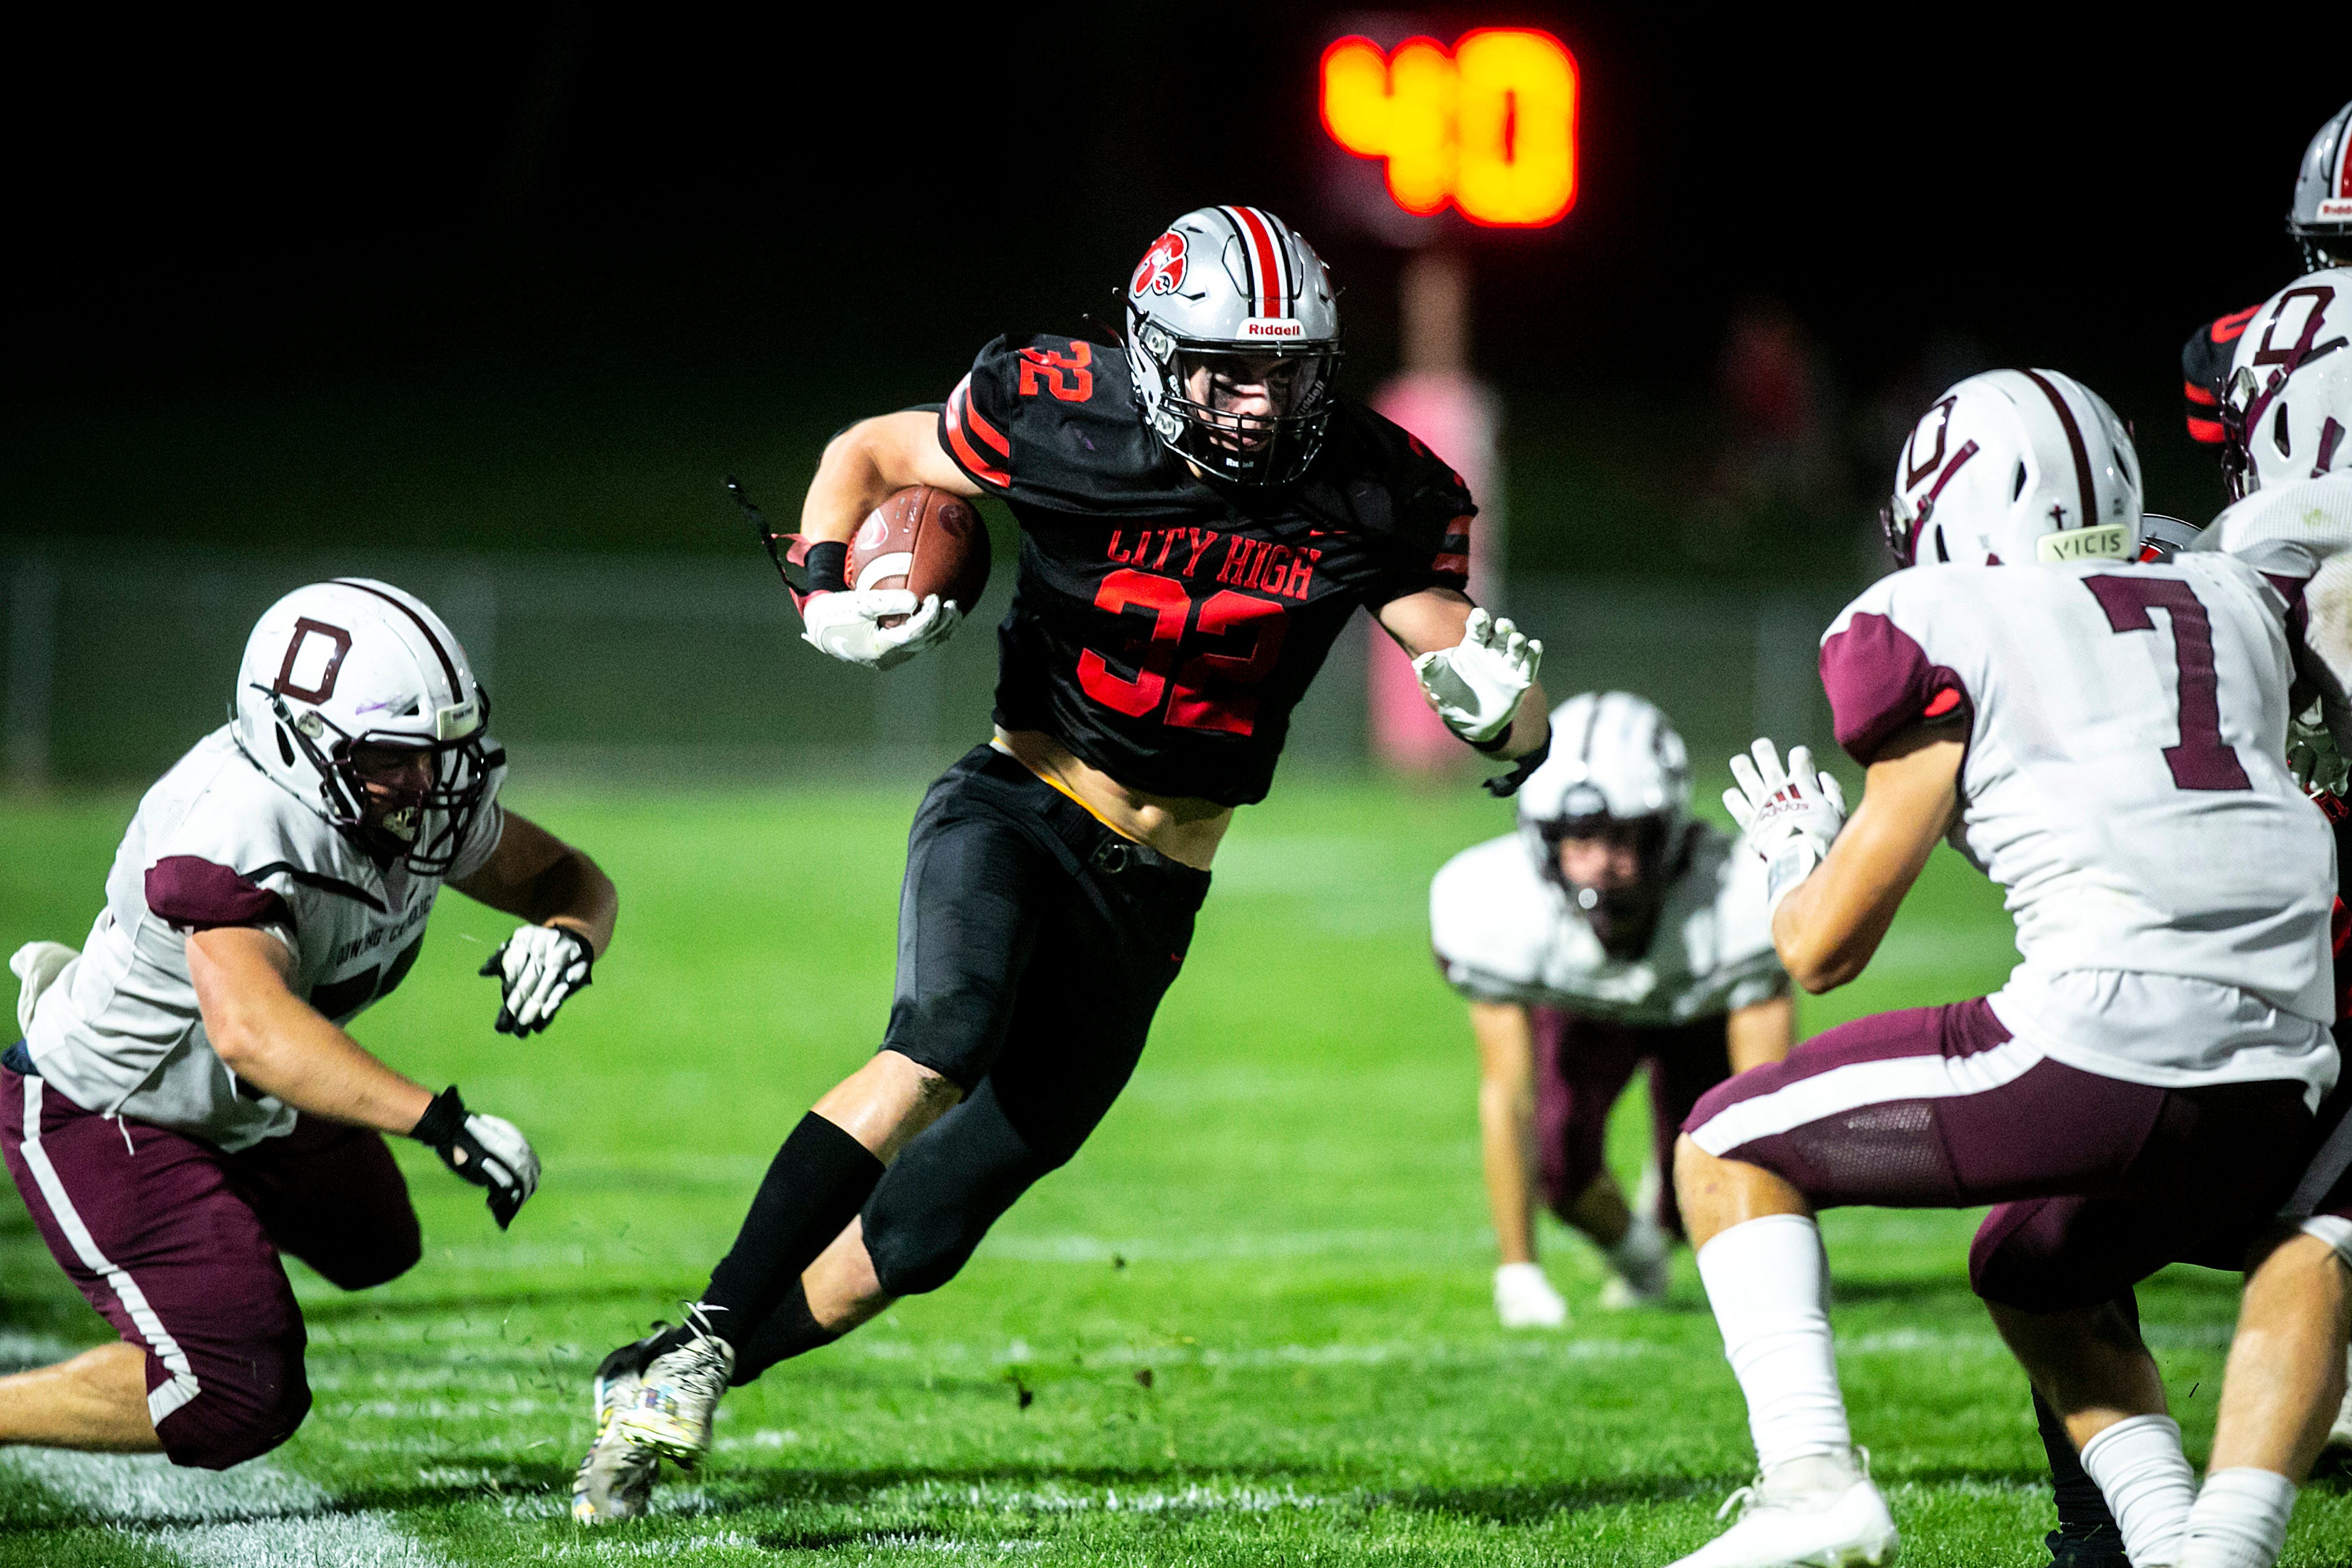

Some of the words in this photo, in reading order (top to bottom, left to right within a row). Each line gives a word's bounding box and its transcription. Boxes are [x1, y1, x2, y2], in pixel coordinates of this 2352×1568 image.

[1321, 27, 1580, 228] 40
[2323, 205, 2352, 215] Ridd
[1248, 324, 1300, 336] Riddell
[2252, 286, 2335, 367] D
[1019, 340, 1093, 402] 32
[1298, 379, 1325, 414] iddell
[1907, 396, 1958, 493] D
[1107, 524, 1218, 577] CITY
[1217, 535, 1322, 600] HIGH
[2053, 532, 2121, 559] VICIS
[272, 616, 353, 706] D
[1077, 567, 1288, 736] 32
[2080, 574, 2253, 791] 7
